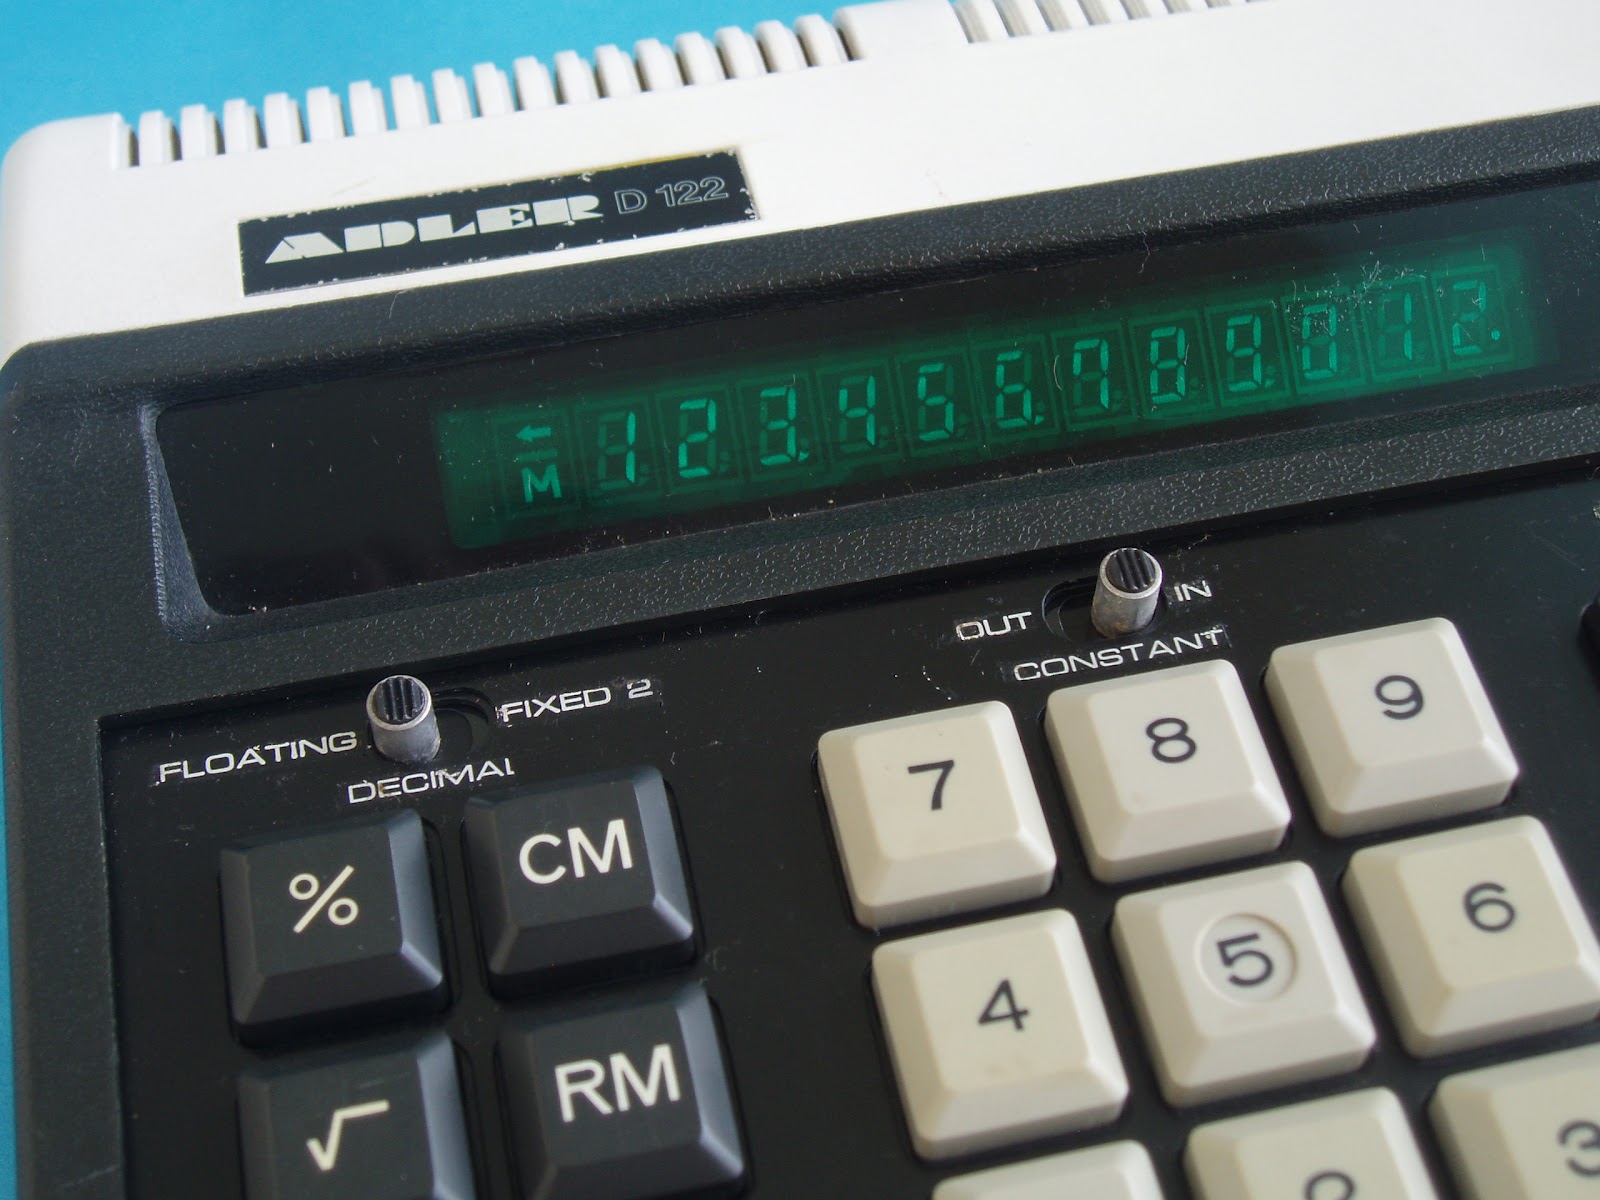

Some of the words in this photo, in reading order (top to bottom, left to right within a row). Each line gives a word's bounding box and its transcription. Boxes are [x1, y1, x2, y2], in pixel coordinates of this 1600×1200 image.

[264, 195, 604, 264] ADLER
[614, 188, 648, 215] D
[655, 176, 729, 207] 122
[522, 464, 561, 503] M
[1173, 580, 1213, 602] IN
[956, 611, 1032, 641] OUT
[1013, 627, 1224, 682] CONSTANT
[500, 685, 612, 722] FIXED
[627, 678, 654, 699] 2
[1374, 674, 1425, 720] 9
[158, 731, 358, 783] FLOATING
[1145, 717, 1198, 764] 8
[348, 757, 515, 804] DECIMAL
[907, 759, 955, 811] 7
[519, 818, 633, 885] CM
[1463, 882, 1515, 932] 6
[1216, 933, 1274, 988] 5
[978, 980, 1030, 1032] 4
[555, 1043, 681, 1123] RM
